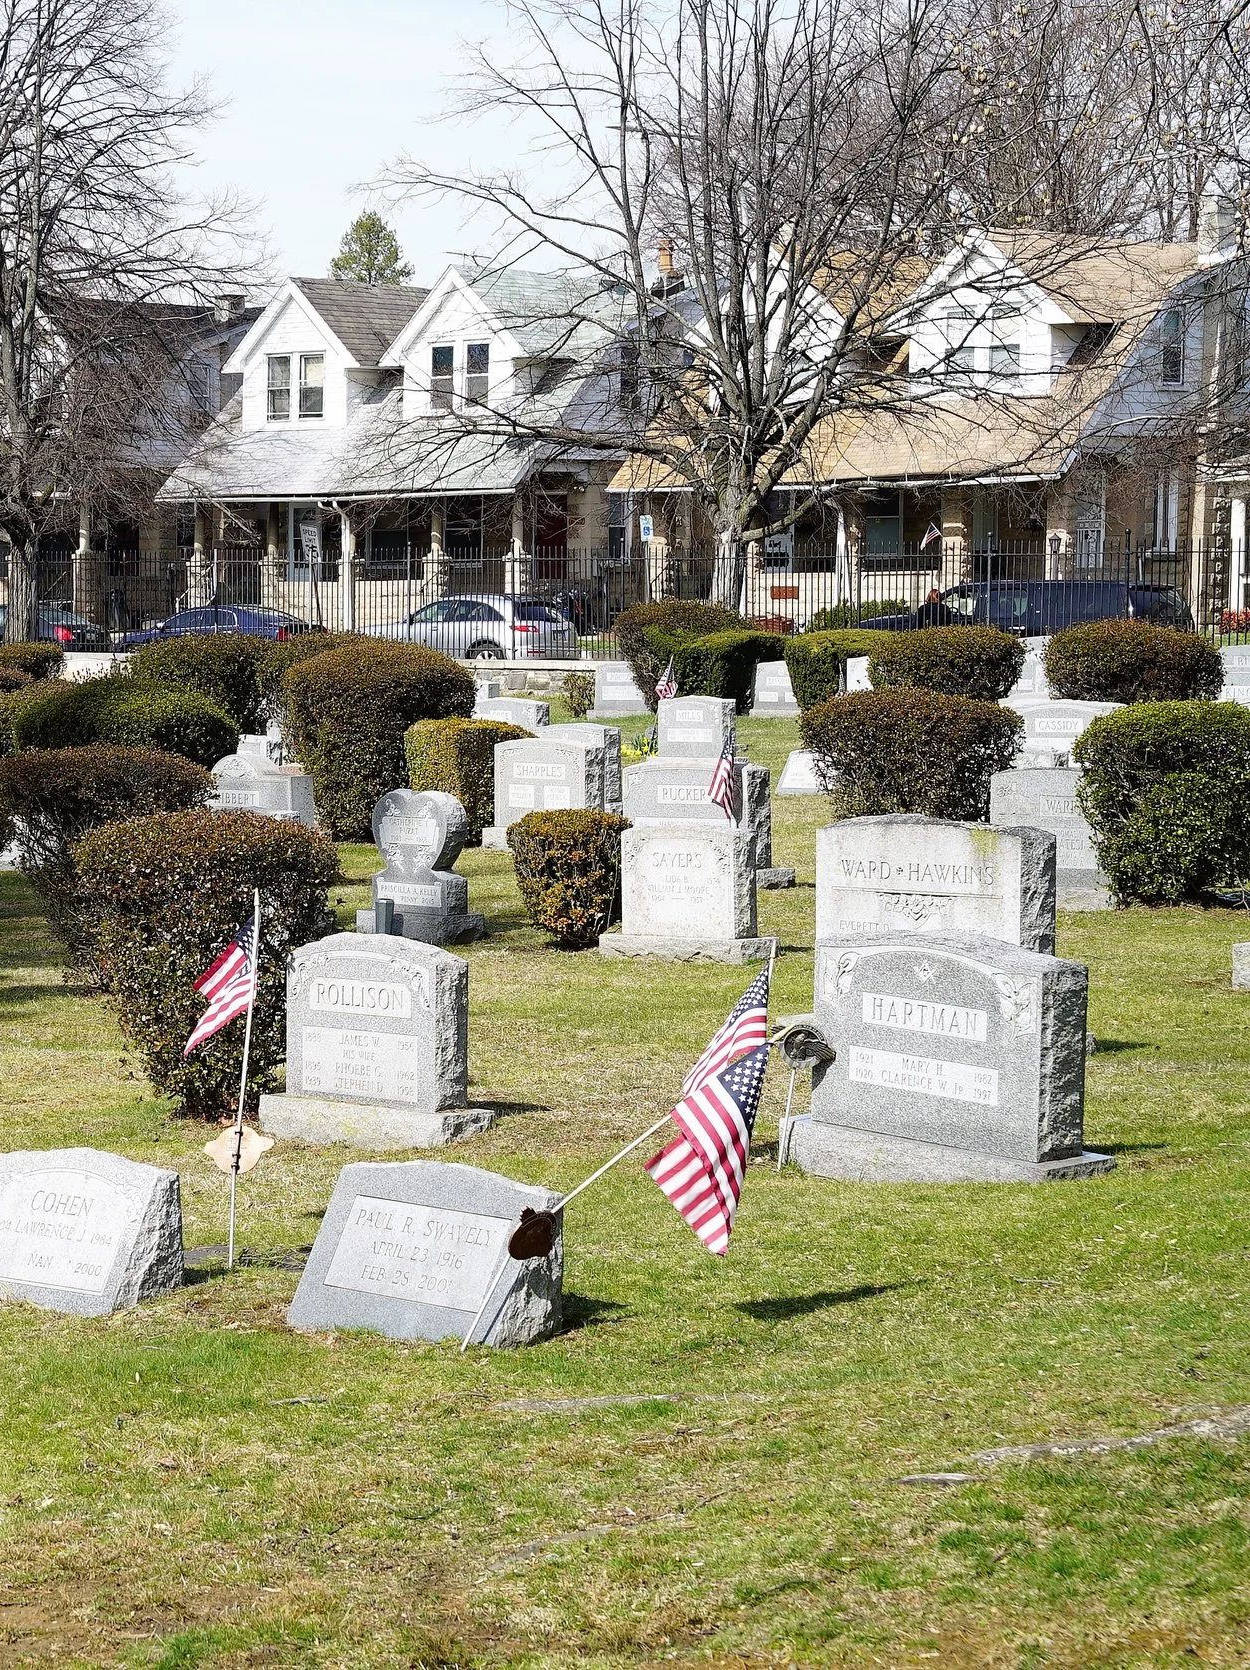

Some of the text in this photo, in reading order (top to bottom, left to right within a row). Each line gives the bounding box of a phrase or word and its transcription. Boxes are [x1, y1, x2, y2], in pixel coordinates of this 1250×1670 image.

[678, 711, 700, 721] MILLS
[1038, 720, 1078, 731] CASSIDY
[662, 787, 706, 801] RUCKER
[652, 851, 702, 869] SAYERS
[841, 859, 995, 886] WARD HAWKINS
[419, 888, 438, 897] KELLY
[316, 983, 405, 1011] ROLLISON
[872, 997, 978, 1036] HARTMAN
[338, 1034, 369, 1048] JAMES
[335, 1062, 371, 1078] PHOEBE
[855, 1051, 874, 1065] 1921
[901, 1057, 930, 1074] MARY
[881, 1069, 933, 1091] CLARENCE
[973, 1088, 992, 1101] 1997
[30, 1189, 95, 1217] COHEN
[15, 1219, 76, 1241] LAWRENCE
[90, 1233, 113, 1246] 1984
[355, 1208, 394, 1232] PAUL
[423, 1220, 498, 1248] SWAVELY
[27, 1252, 54, 1269] NAN
[73, 1261, 103, 1277] 2000
[370, 1240, 404, 1260] APRIL
[436, 1251, 467, 1270] 1916
